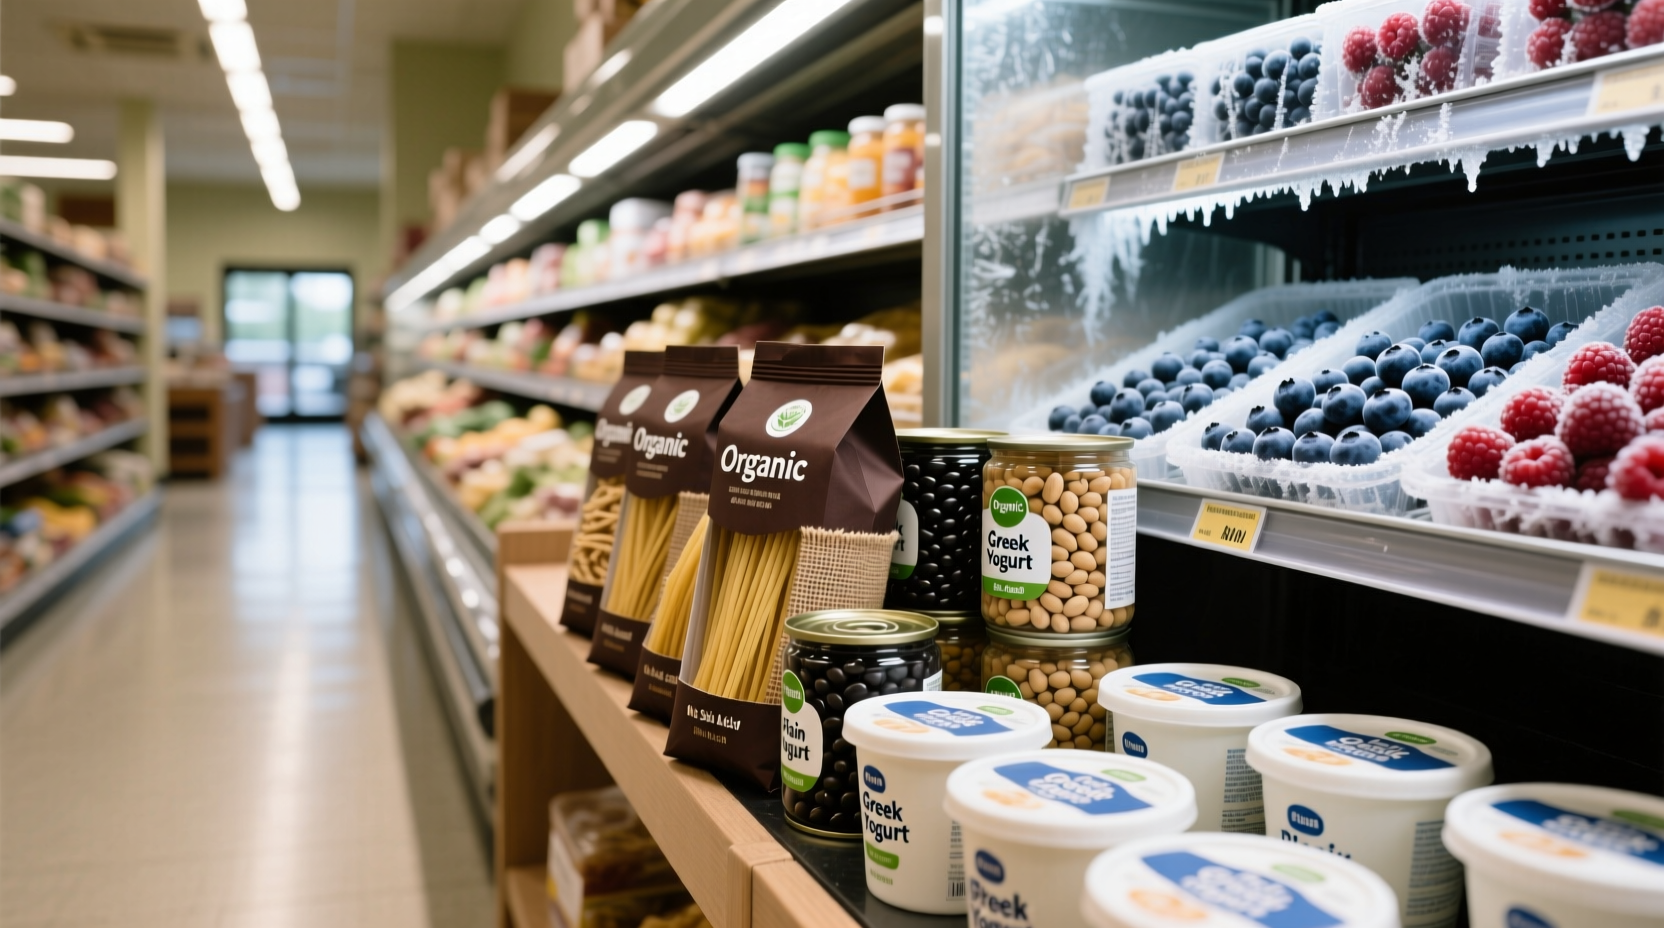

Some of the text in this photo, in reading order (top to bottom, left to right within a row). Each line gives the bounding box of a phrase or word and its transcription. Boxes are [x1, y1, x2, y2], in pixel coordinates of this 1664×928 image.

[634, 427, 689, 459] Organic
[721, 444, 808, 483] Organic
[988, 530, 1029, 552] Greek
[987, 548, 1033, 573] Yogurt
[863, 791, 903, 822] Greek
[864, 812, 910, 843] Yogurt
